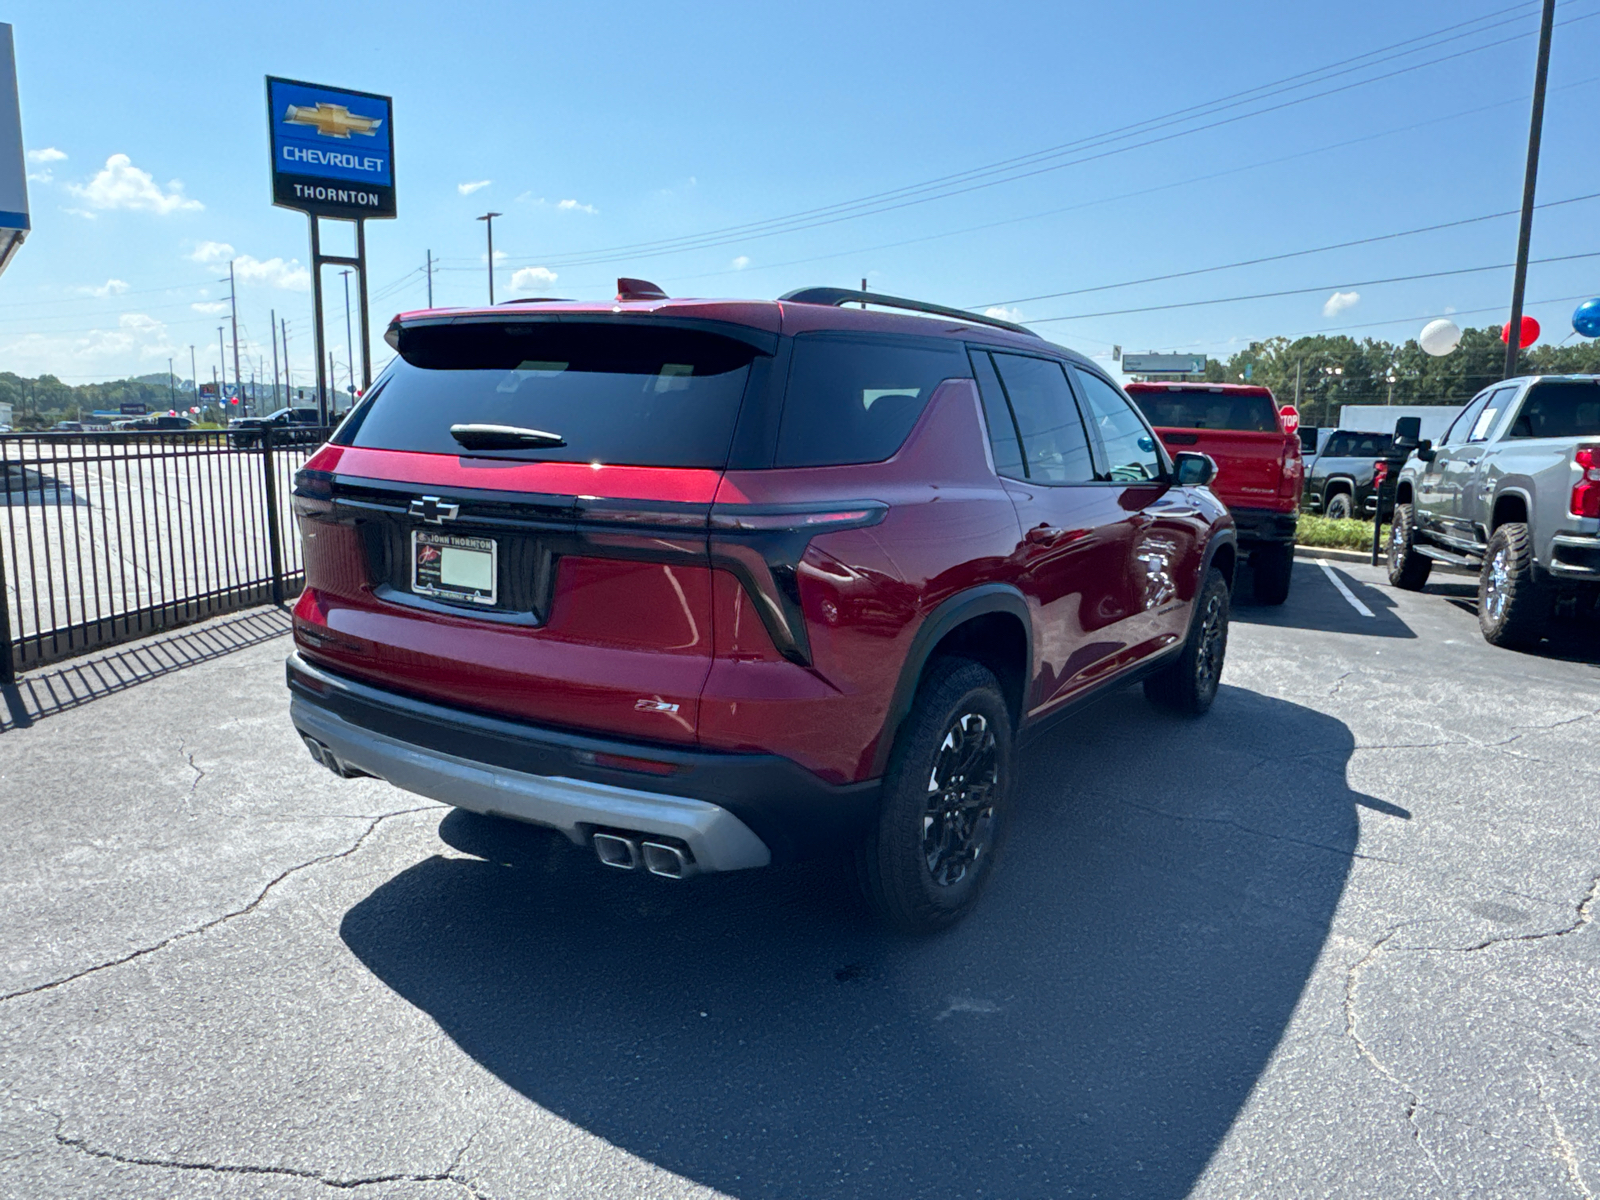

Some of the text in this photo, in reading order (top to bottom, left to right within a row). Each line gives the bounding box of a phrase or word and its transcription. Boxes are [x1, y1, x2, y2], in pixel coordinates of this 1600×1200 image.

[283, 146, 384, 172] CHEVROLET
[294, 184, 379, 206] THORNTON
[431, 534, 450, 544] JOHN
